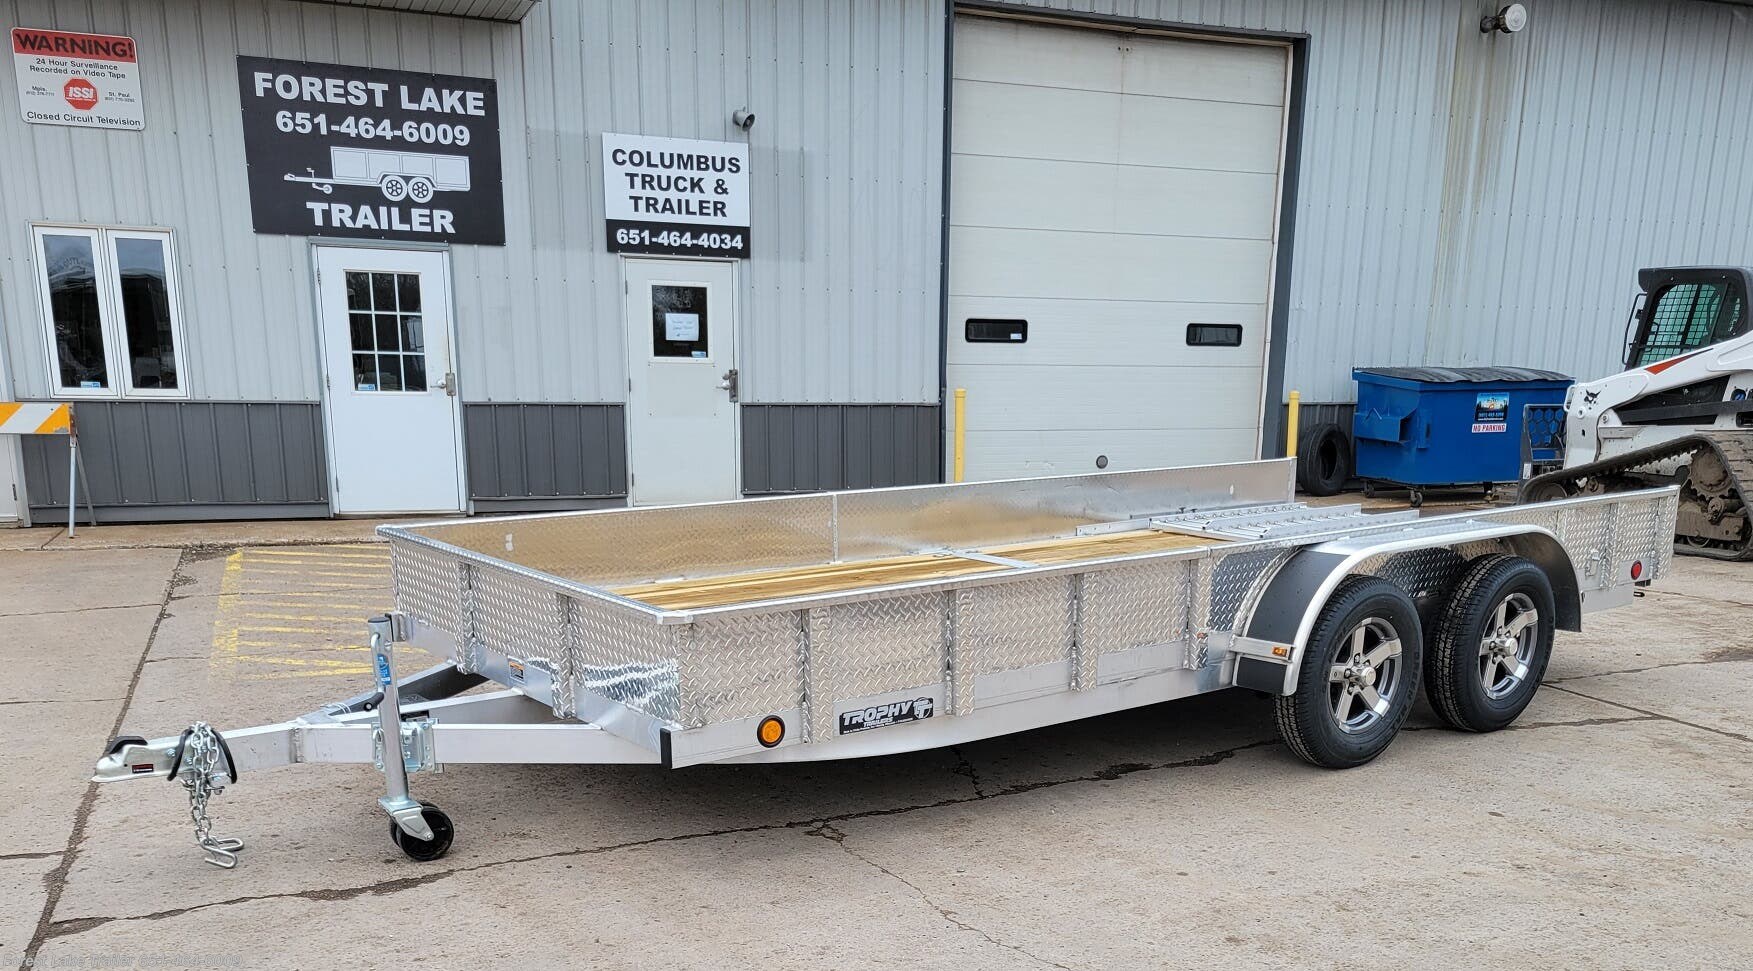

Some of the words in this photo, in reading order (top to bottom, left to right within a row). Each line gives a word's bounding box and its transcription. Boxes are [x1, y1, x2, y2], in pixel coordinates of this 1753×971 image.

[15, 33, 134, 58] WARNING!
[30, 65, 68, 75] Recorded
[83, 69, 106, 77] Video
[108, 71, 126, 80] Tape
[70, 60, 118, 70] Surveillance
[68, 86, 94, 99] ISSI
[253, 71, 388, 108] FOREST
[400, 85, 486, 117] LAKE
[26, 111, 60, 120] Closed
[63, 113, 94, 123] Circuit
[95, 115, 141, 127] Television
[275, 110, 470, 146] 651-464-6009
[611, 148, 741, 174] COLUMBUS
[624, 172, 706, 194] TRUCK
[713, 178, 729, 195] &
[305, 201, 456, 234] TRAILER
[628, 195, 728, 218] TRAILER
[616, 228, 743, 250] 651-464-4034
[843, 701, 913, 726] TROPHY
